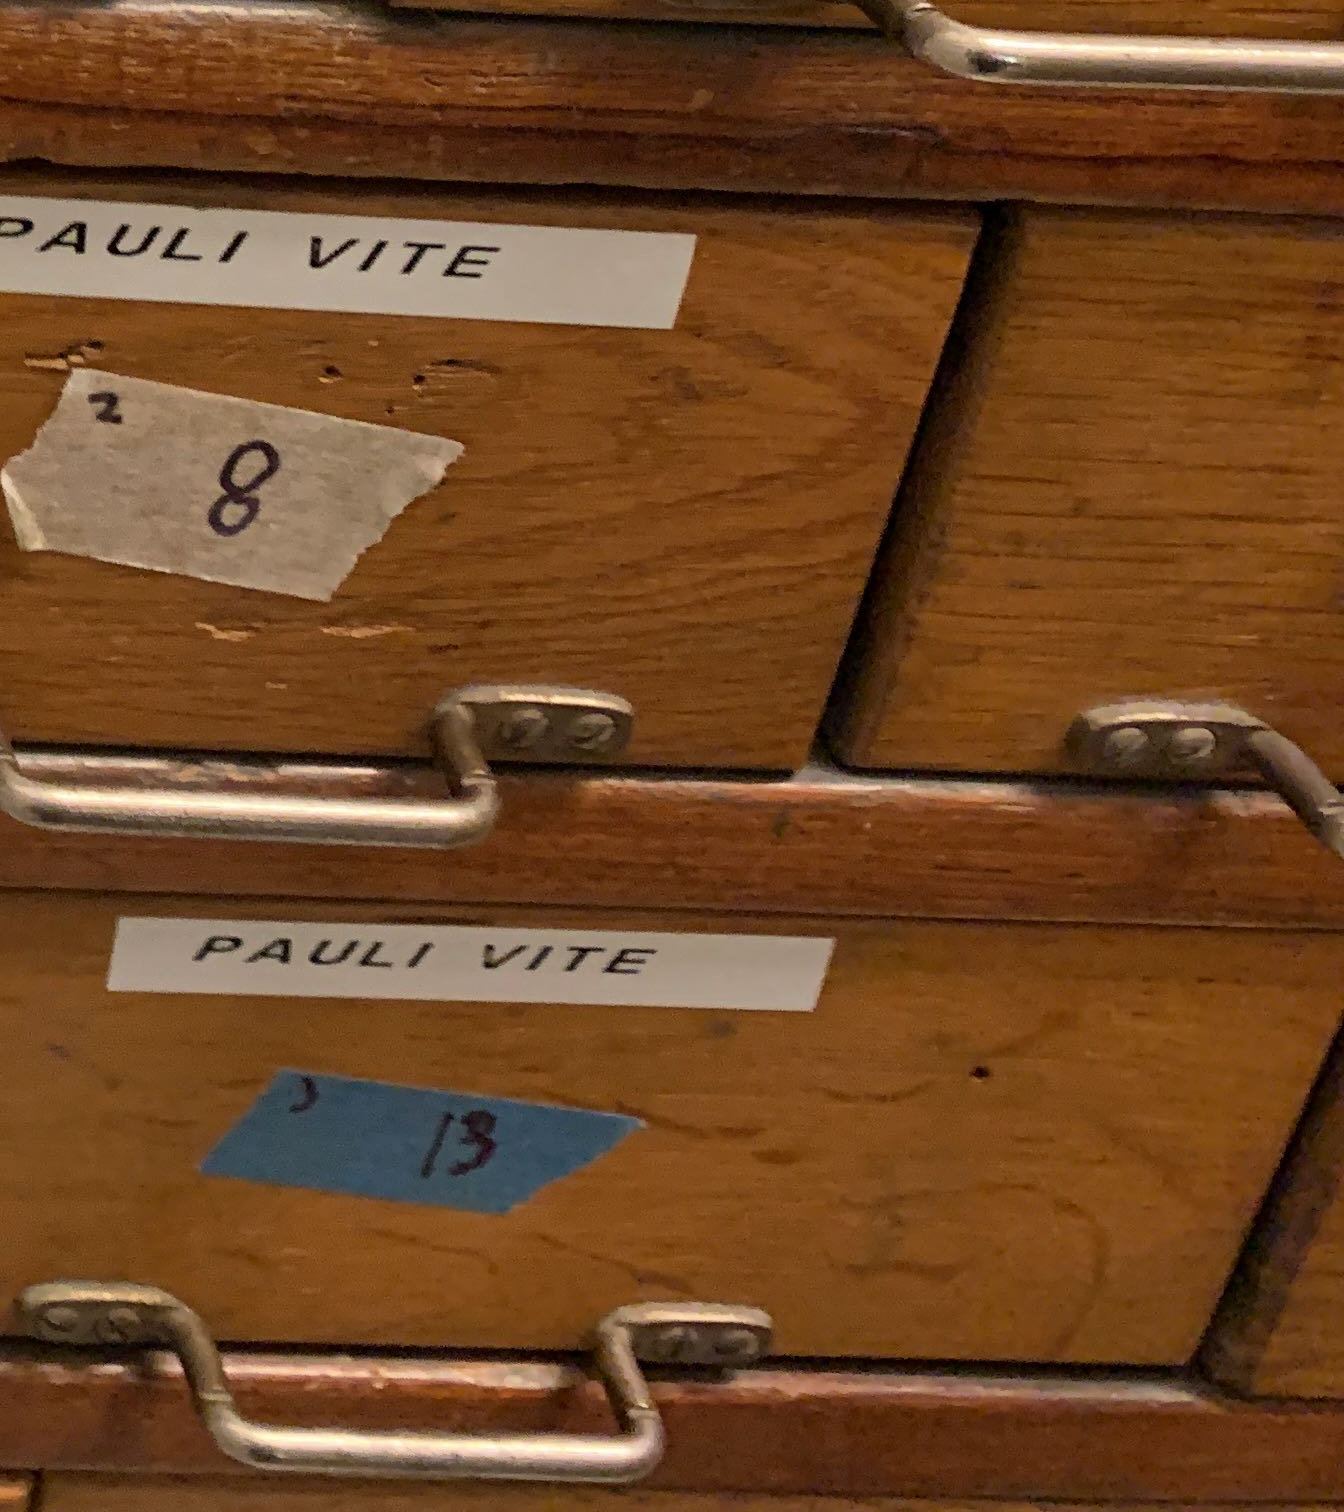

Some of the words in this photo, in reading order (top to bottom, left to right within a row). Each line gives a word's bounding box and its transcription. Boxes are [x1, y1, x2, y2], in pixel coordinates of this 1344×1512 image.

[308, 234, 502, 280] VITE
[206, 438, 282, 538] 8
[193, 933, 435, 970] PAULI
[481, 943, 659, 977] VITE
